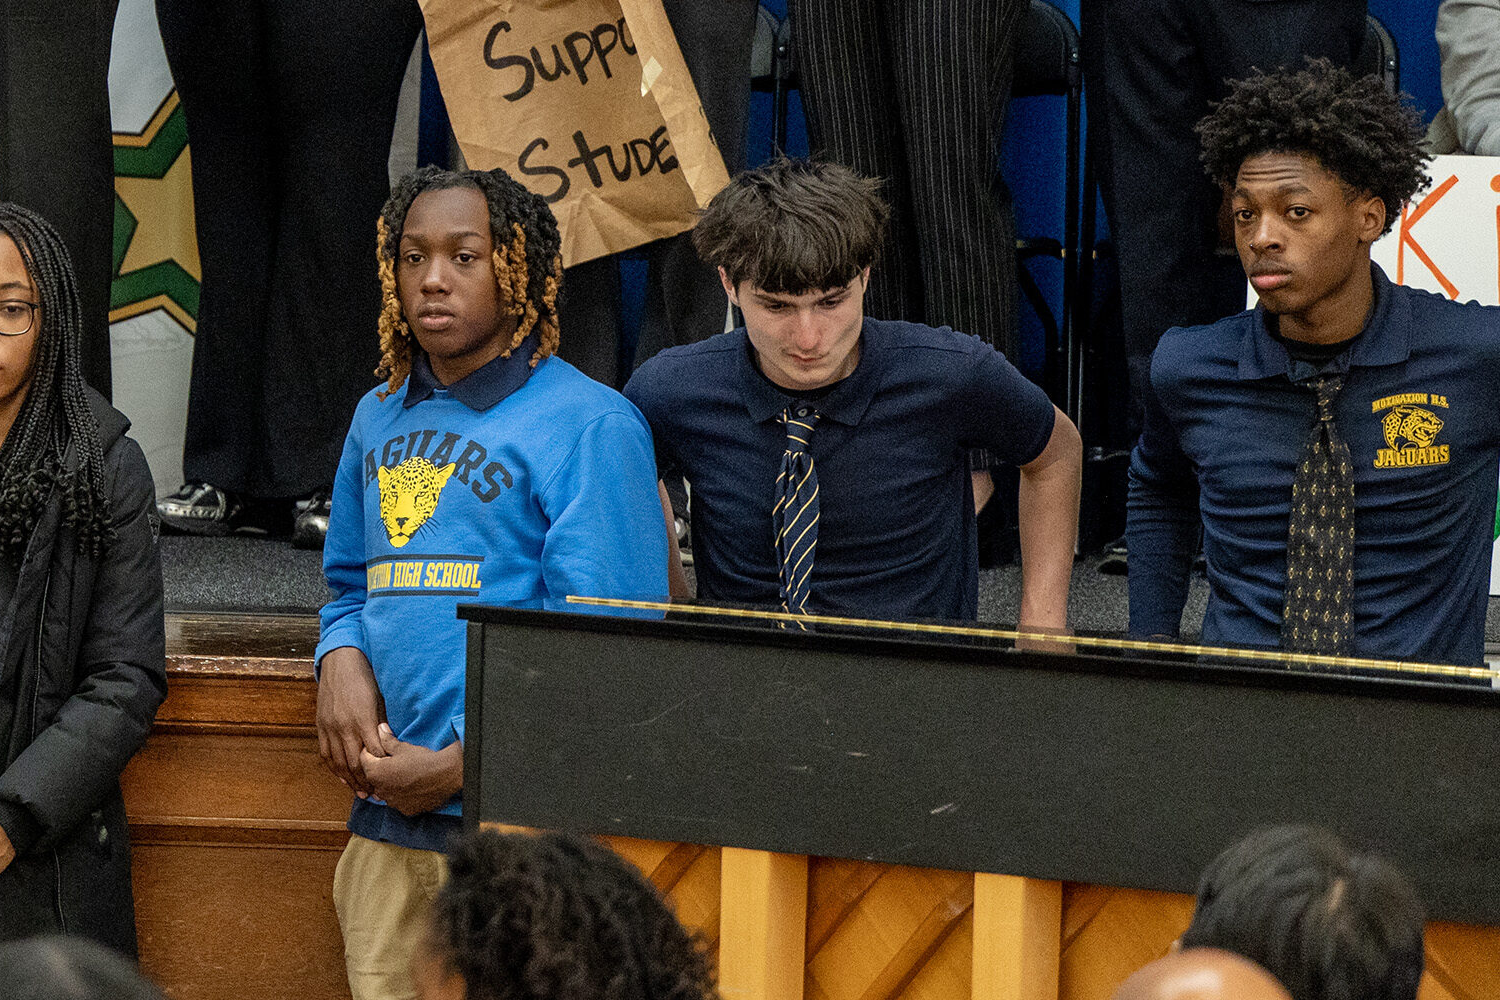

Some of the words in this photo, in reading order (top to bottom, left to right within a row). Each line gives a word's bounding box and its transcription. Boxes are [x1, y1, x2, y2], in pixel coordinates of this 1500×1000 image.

[1371, 392, 1428, 414] MOTIVATION
[1373, 444, 1451, 469] JAGUARS
[392, 562, 424, 588] HIGH
[423, 561, 482, 589] SCHOOL
